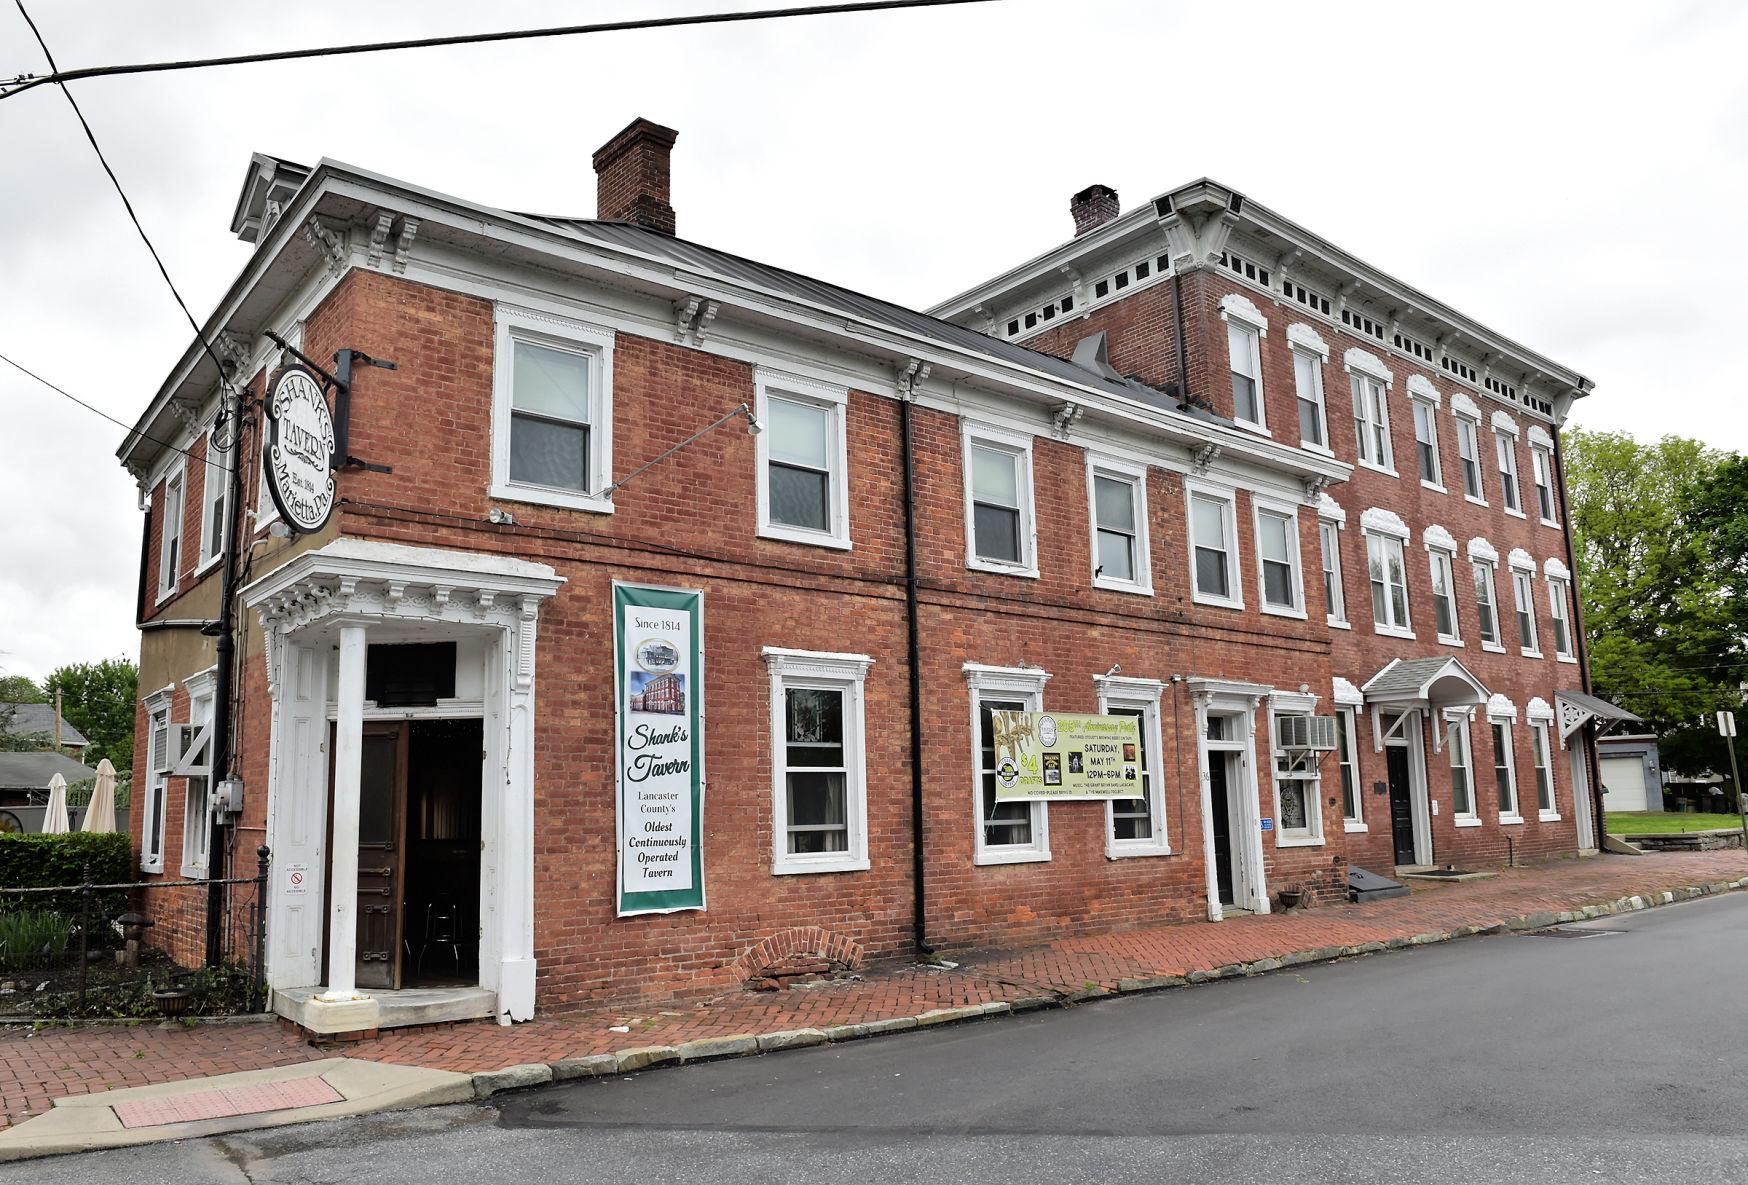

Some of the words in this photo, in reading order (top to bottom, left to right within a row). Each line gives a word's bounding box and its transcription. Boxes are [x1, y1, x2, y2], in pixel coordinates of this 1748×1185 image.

[279, 377, 329, 440] SHANK'S
[283, 417, 326, 461] TAVERN
[635, 617, 660, 630] Since
[661, 620, 681, 632] 1814
[628, 724, 688, 750] Shank's
[1084, 744, 1120, 754] SATURDAY,
[1021, 753, 1038, 774] $4
[1090, 758, 1104, 766] MAY
[1106, 757, 1116, 765] 11TH
[627, 754, 690, 782] Tavern
[1020, 776, 1043, 784] DRAFTS
[1087, 770, 1121, 779] 12PM-6PM
[1202, 772, 1209, 781] 36
[638, 792, 678, 801] Lancaster
[640, 804, 676, 815] County's
[644, 821, 673, 832] Oldest
[629, 835, 687, 848] Continuously
[637, 851, 678, 865] Operated
[642, 868, 673, 878] Tavern
